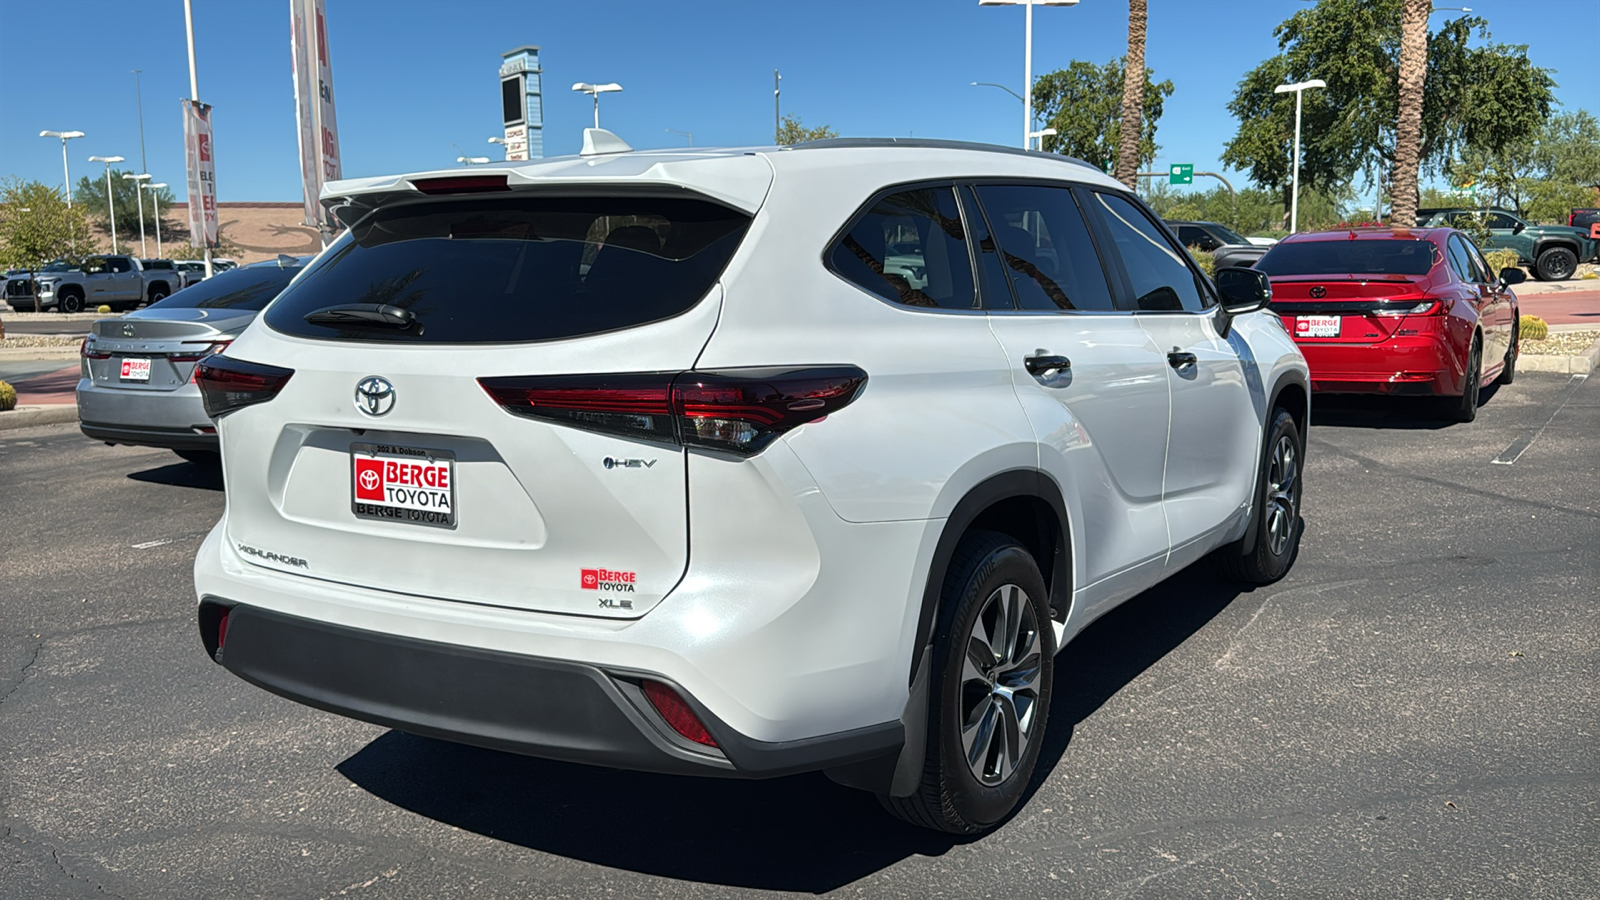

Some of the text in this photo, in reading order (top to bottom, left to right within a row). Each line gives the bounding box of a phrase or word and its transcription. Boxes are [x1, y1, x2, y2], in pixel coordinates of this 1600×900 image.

[131, 362, 149, 370] BERGE
[376, 445, 390, 453] 202
[400, 447, 426, 456] Dobson
[386, 461, 448, 488] BERGE
[386, 488, 450, 508] TOYOTA
[357, 505, 449, 524] BERGE TOYOTA
[237, 543, 310, 570] HIGHLANDER
[598, 568, 636, 583] BERGE
[598, 582, 635, 593] TOYOTA
[598, 598, 633, 610] XLE
